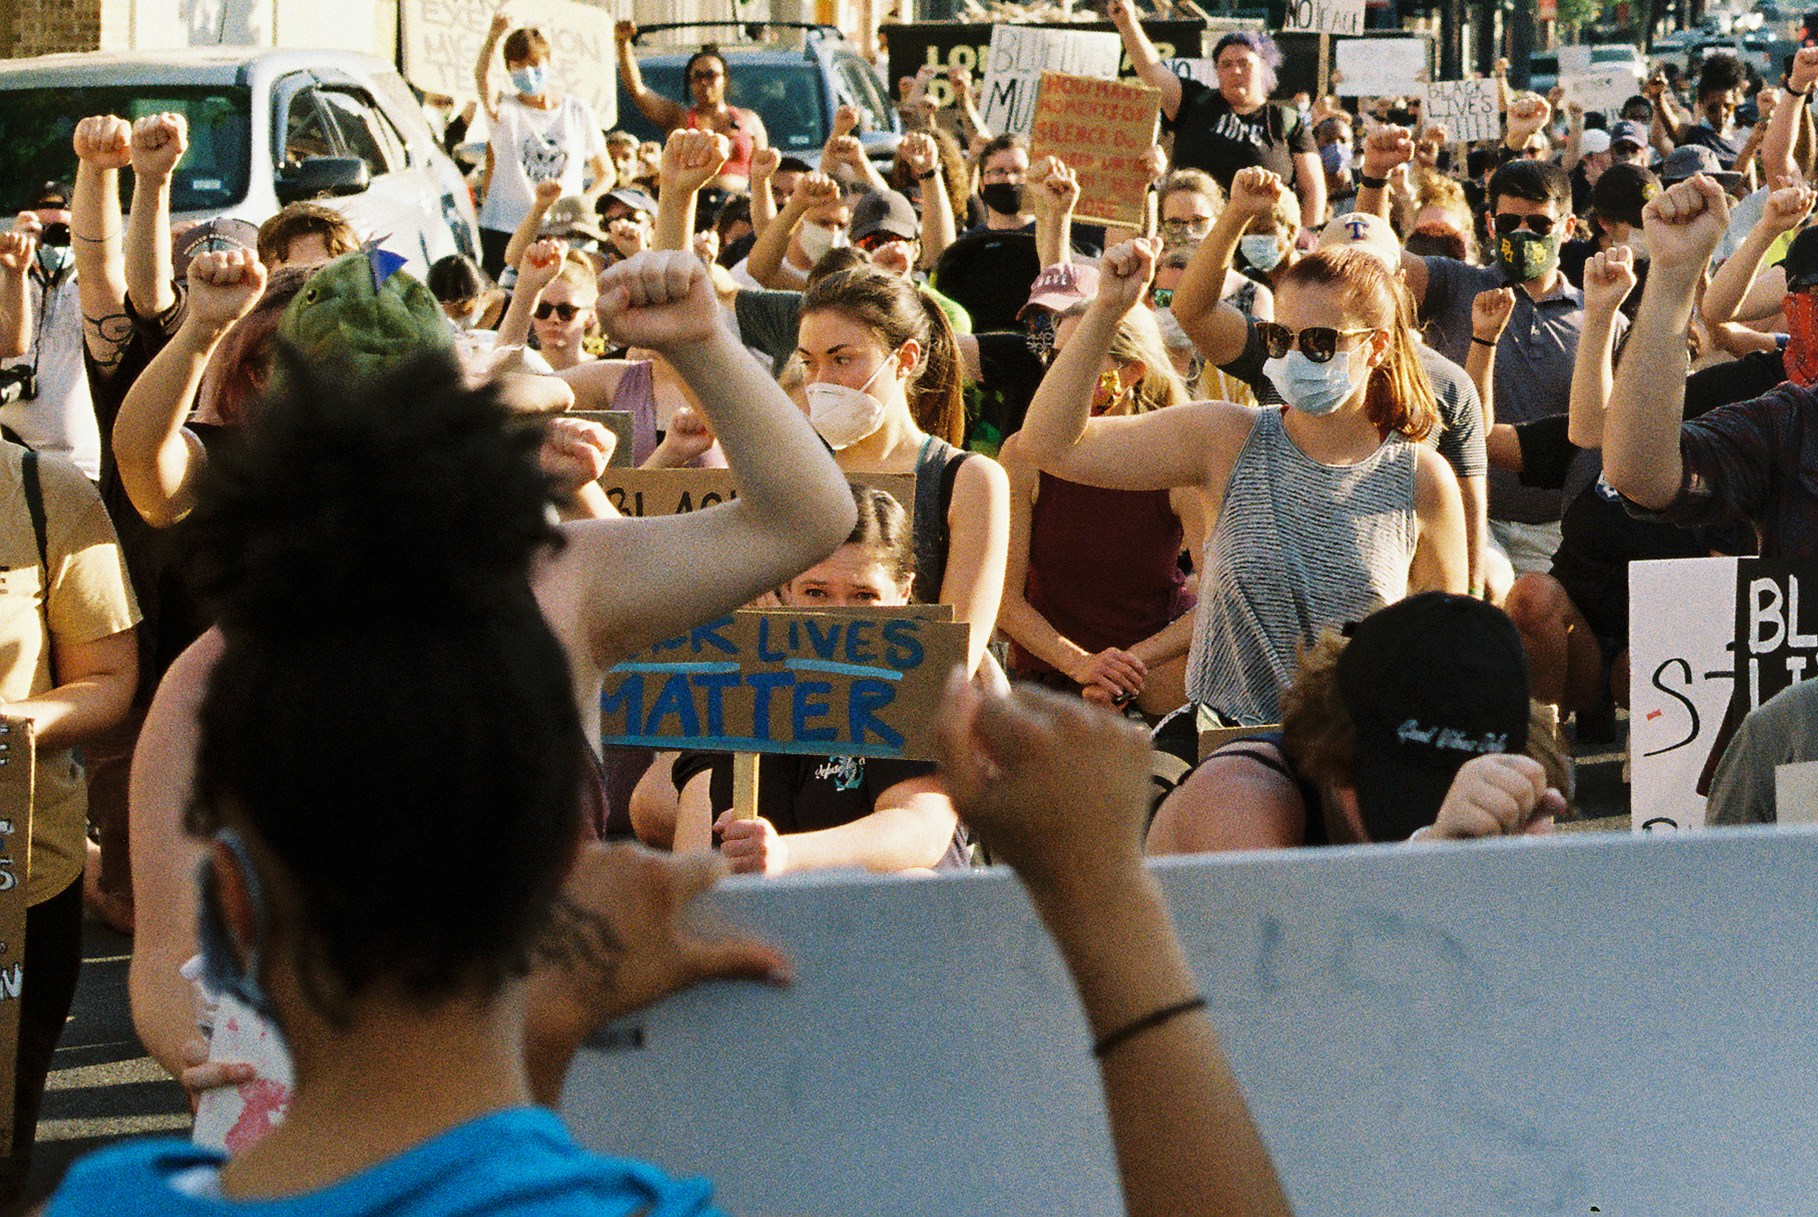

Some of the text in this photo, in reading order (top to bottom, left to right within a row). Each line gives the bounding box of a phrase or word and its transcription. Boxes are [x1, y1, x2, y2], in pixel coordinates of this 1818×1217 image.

[1427, 94, 1494, 117] LIVES
[757, 614, 925, 670] LIVES
[600, 670, 904, 749] MATTER
